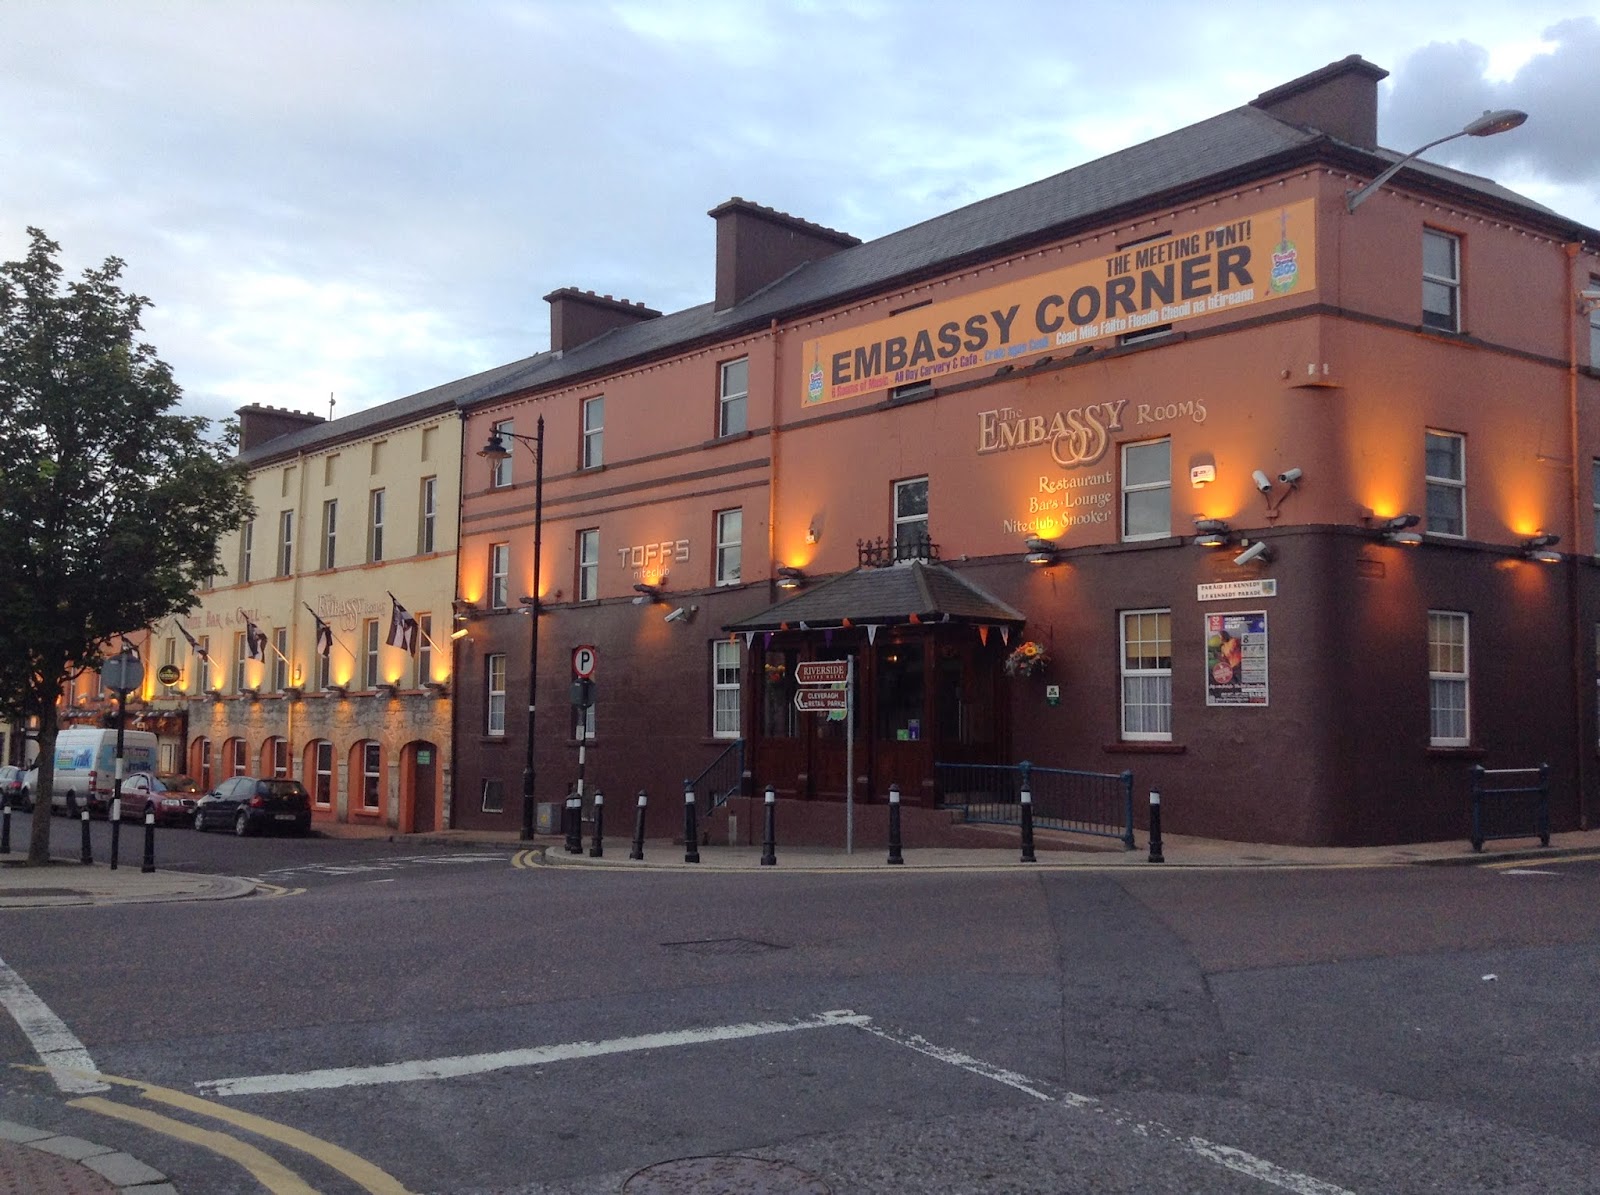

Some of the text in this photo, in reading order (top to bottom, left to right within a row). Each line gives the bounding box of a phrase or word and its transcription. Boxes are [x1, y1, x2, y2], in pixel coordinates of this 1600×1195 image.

[1106, 253, 1131, 277] THE
[1136, 234, 1200, 269] MEETING
[831, 245, 1255, 386] EMBASSY CORNER
[1129, 309, 1159, 328] Fleadh
[1192, 301, 1206, 314] na
[905, 368, 918, 382] Day
[920, 361, 951, 378] Carvery
[952, 358, 959, 369] &
[1000, 407, 1022, 421] The
[977, 399, 1129, 467] EMBASSY
[1038, 471, 1112, 493] Restaurant
[1029, 491, 1112, 513] Bars Lounge
[1003, 509, 1112, 534] Niteclub Snooker
[618, 539, 690, 569] TOFFS
[633, 565, 670, 579] niteclub
[581, 651, 590, 671] P
[803, 665, 844, 675] RIVERSIDE
